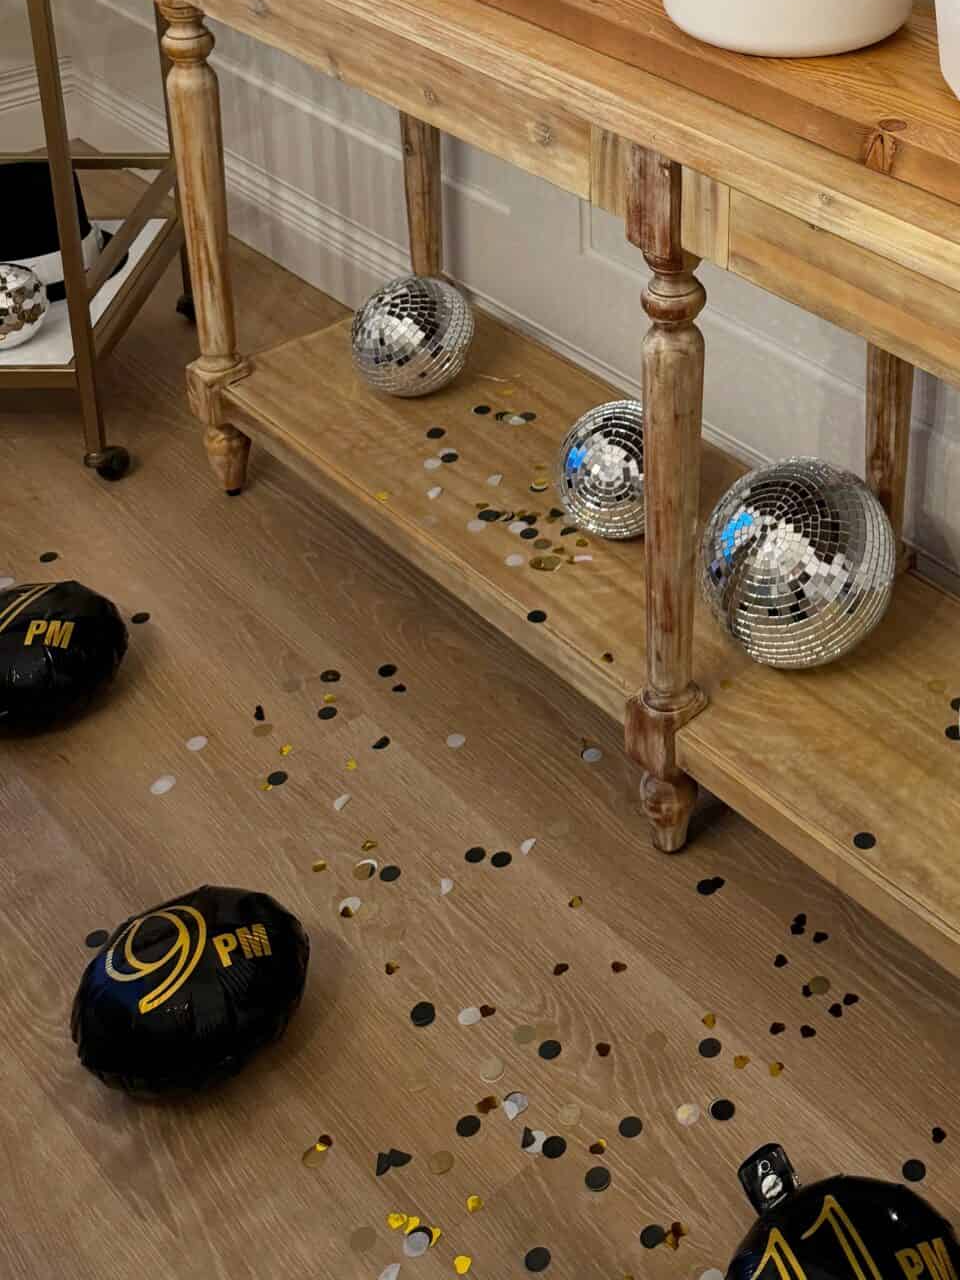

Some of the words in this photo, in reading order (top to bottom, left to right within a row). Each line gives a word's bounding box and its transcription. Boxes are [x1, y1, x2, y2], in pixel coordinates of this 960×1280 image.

[24, 619, 76, 649] PM
[105, 905, 207, 1015] 9
[212, 923, 272, 969] PM
[895, 1237, 958, 1280] PM
